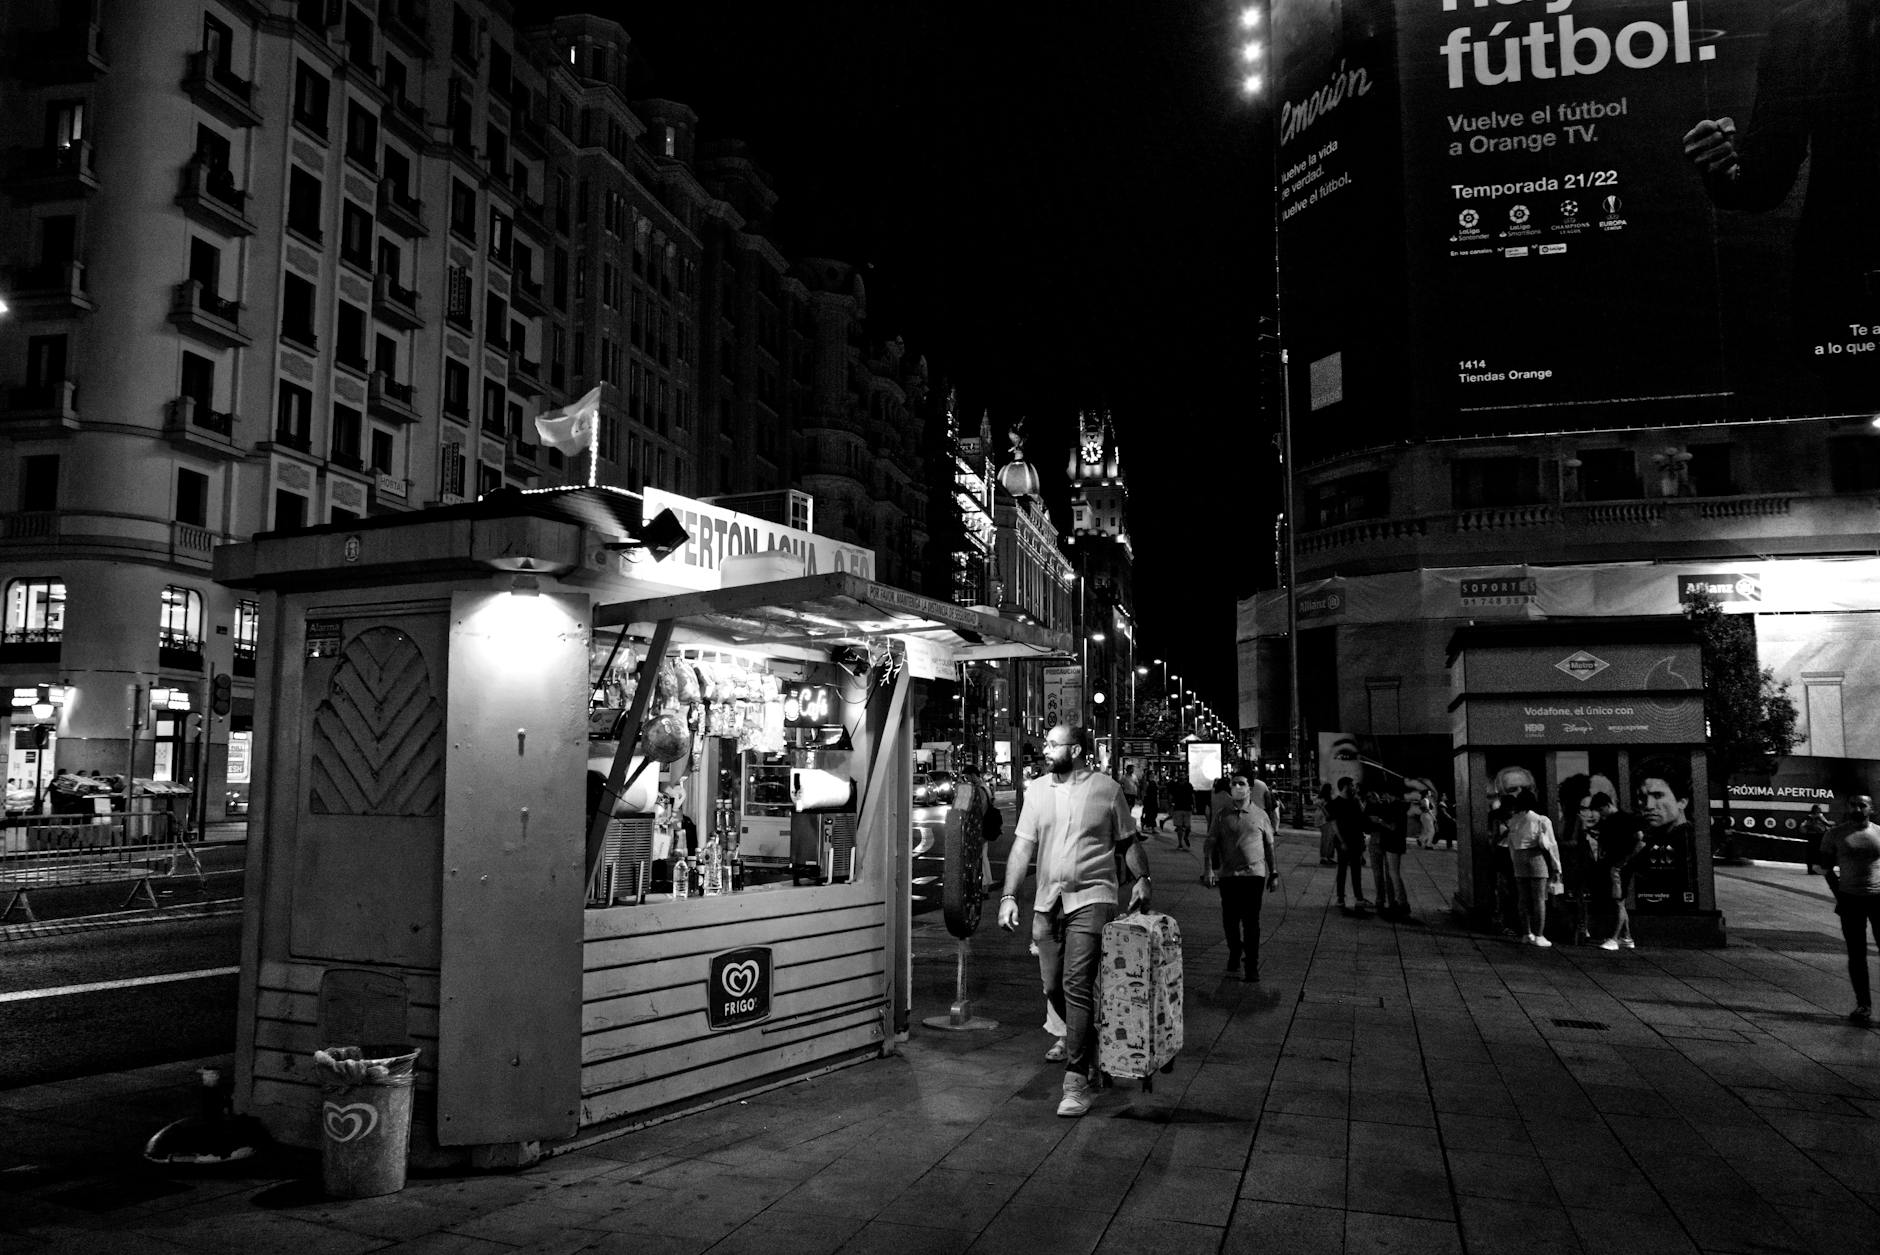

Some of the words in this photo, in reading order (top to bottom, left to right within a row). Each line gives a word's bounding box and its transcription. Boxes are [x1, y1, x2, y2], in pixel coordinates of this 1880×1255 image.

[1439, 1, 1716, 89] fútbol.
[1447, 111, 1525, 133] Vuelve
[1531, 105, 1551, 124] el
[1557, 97, 1628, 122] fútbol
[1448, 141, 1463, 156] a
[1469, 131, 1557, 152] Orange
[1562, 123, 1598, 144] TV.
[1308, 154, 1317, 166] la
[1318, 140, 1338, 160] vida
[1291, 164, 1325, 193] verdad.
[1451, 177, 1559, 199] Temporada
[1564, 170, 1619, 189] 21/22
[1309, 189, 1318, 204] el
[1319, 172, 1352, 199] fútbol.
[1550, 222, 1591, 231] CHAMPIONS
[1599, 219, 1628, 228] EUROPA
[1458, 234, 1490, 242] Santander
[1849, 324, 1868, 336] Te
[1814, 345, 1824, 355] a
[1828, 342, 1842, 354] lo
[1846, 342, 1876, 355] que
[1458, 359, 1486, 370] 1414
[1458, 371, 1505, 383] Tiendas
[1508, 369, 1553, 381] Orange
[1462, 581, 1535, 593] SOPORTES
[1299, 600, 1327, 613] Allianz
[309, 623, 339, 632] Alarma
[1570, 661, 1594, 670] Metro
[1524, 707, 1573, 716] Vodafone,
[1574, 706, 1584, 715] el
[1586, 706, 1613, 716] único
[1776, 787, 1834, 799] APERTURA
[724, 998, 755, 1017] FRIGO
